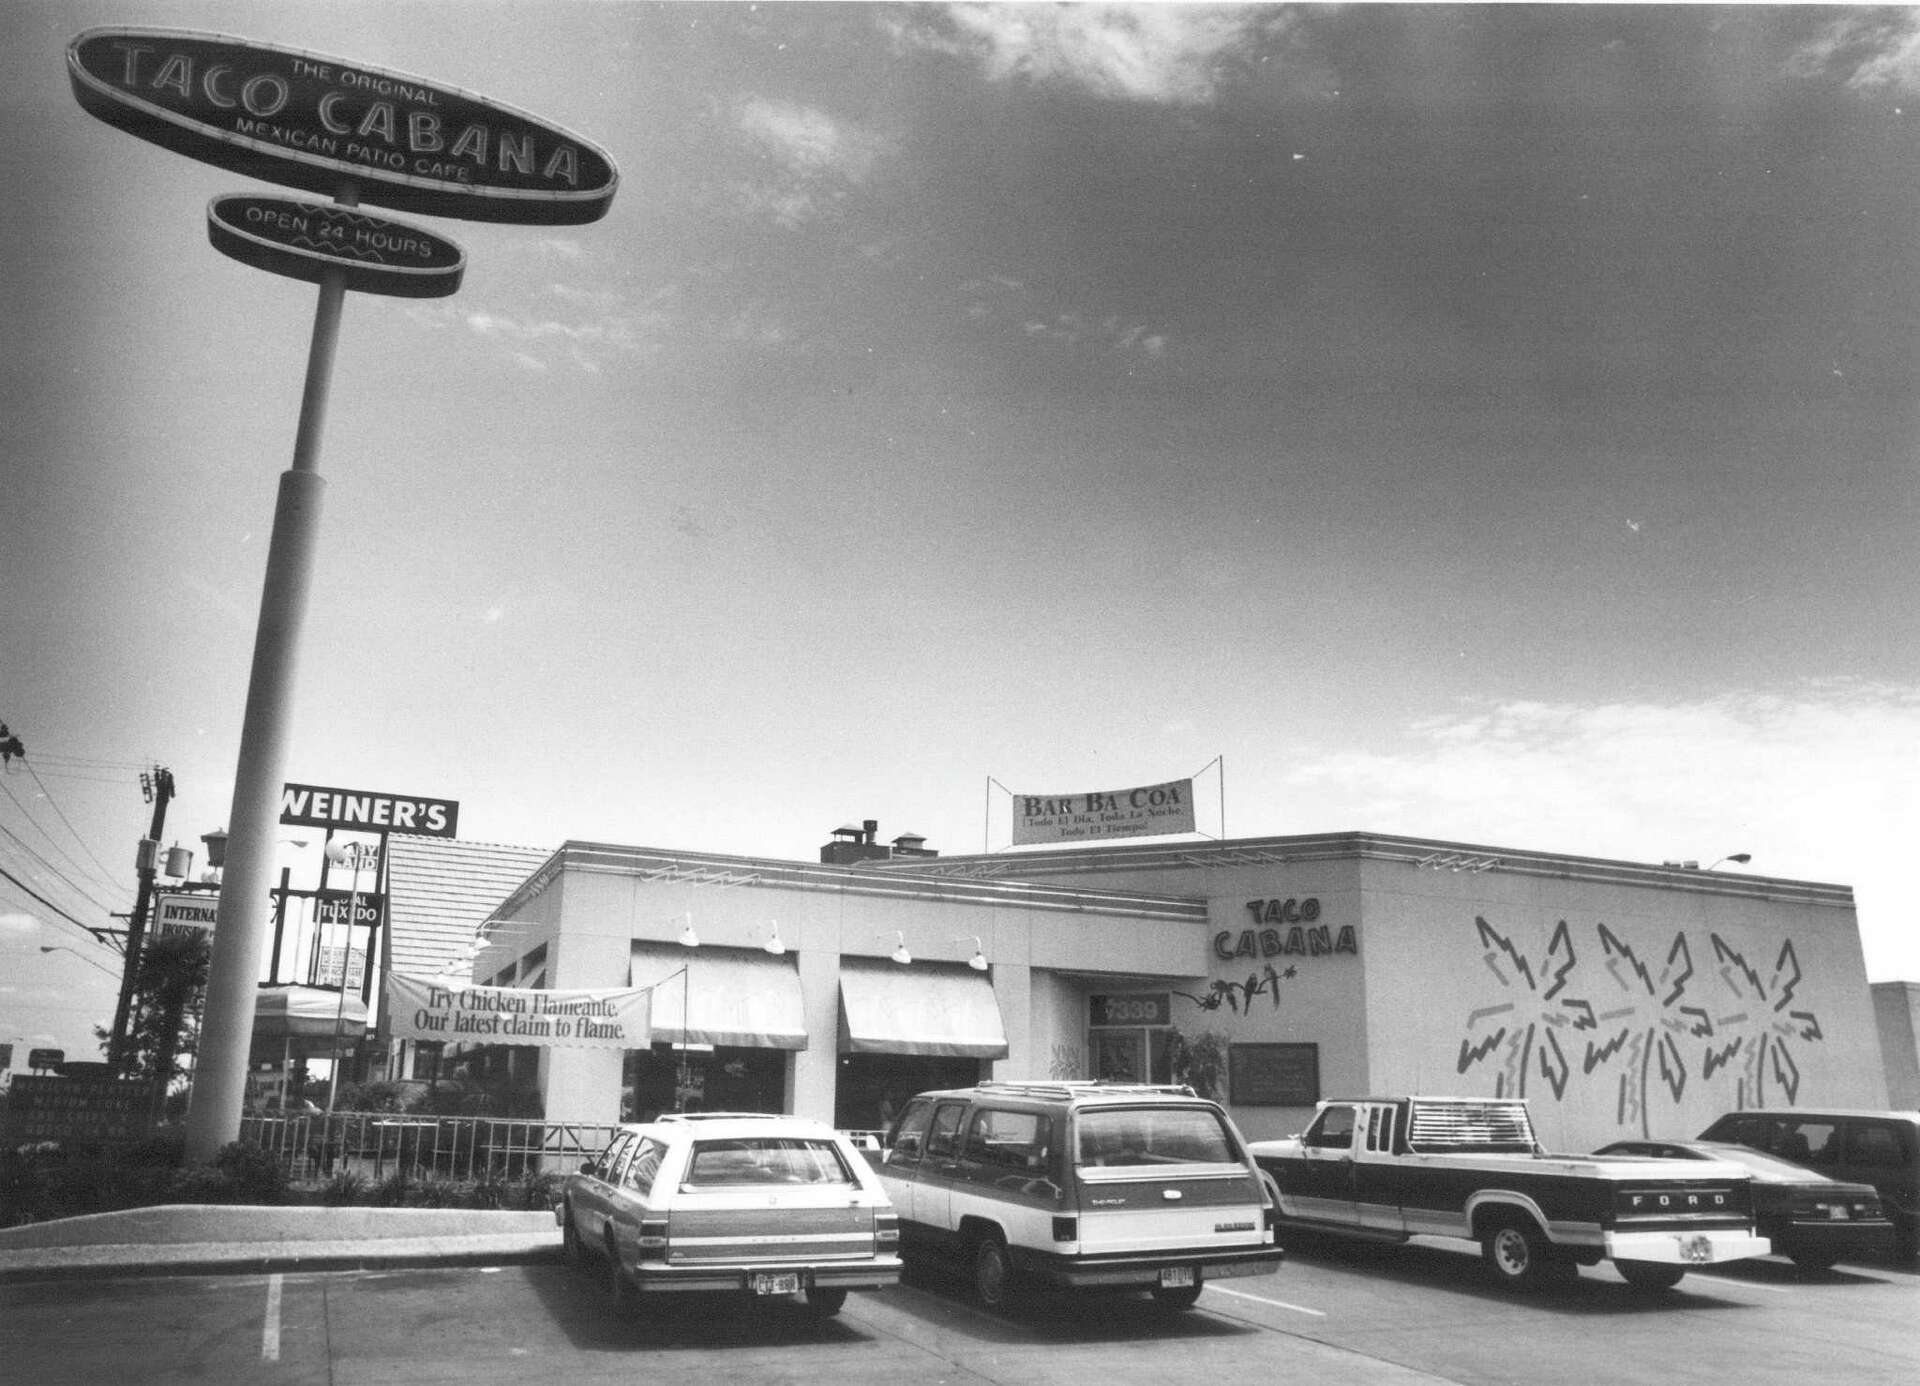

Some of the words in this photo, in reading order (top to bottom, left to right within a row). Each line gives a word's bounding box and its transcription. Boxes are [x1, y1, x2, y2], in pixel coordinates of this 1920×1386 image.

[290, 59, 332, 81] THE
[341, 71, 439, 106] ORIGINAL
[112, 42, 289, 116] TACO
[318, 92, 579, 186] CABANA
[236, 117, 336, 154] MEXICAN
[346, 142, 405, 168] PATIO
[245, 205, 308, 234] OPEN
[318, 221, 344, 240] 24
[355, 227, 433, 259] HOURS
[1023, 797, 1072, 817] BAR
[1086, 792, 1118, 813] BA
[1129, 787, 1181, 809] COA
[1130, 810, 1143, 820] La
[321, 904, 377, 921] TUXDO
[1246, 897, 1321, 925] TACO
[1213, 924, 1358, 960] CABANA
[427, 986, 452, 1011] Try
[459, 988, 526, 1014] Chicken
[414, 1008, 449, 1032] Our
[454, 1010, 501, 1035] latest
[503, 1014, 551, 1037] claim
[556, 1018, 571, 1038] to
[575, 1016, 626, 1039] flame.
[1632, 1194, 1725, 1206] FORD
